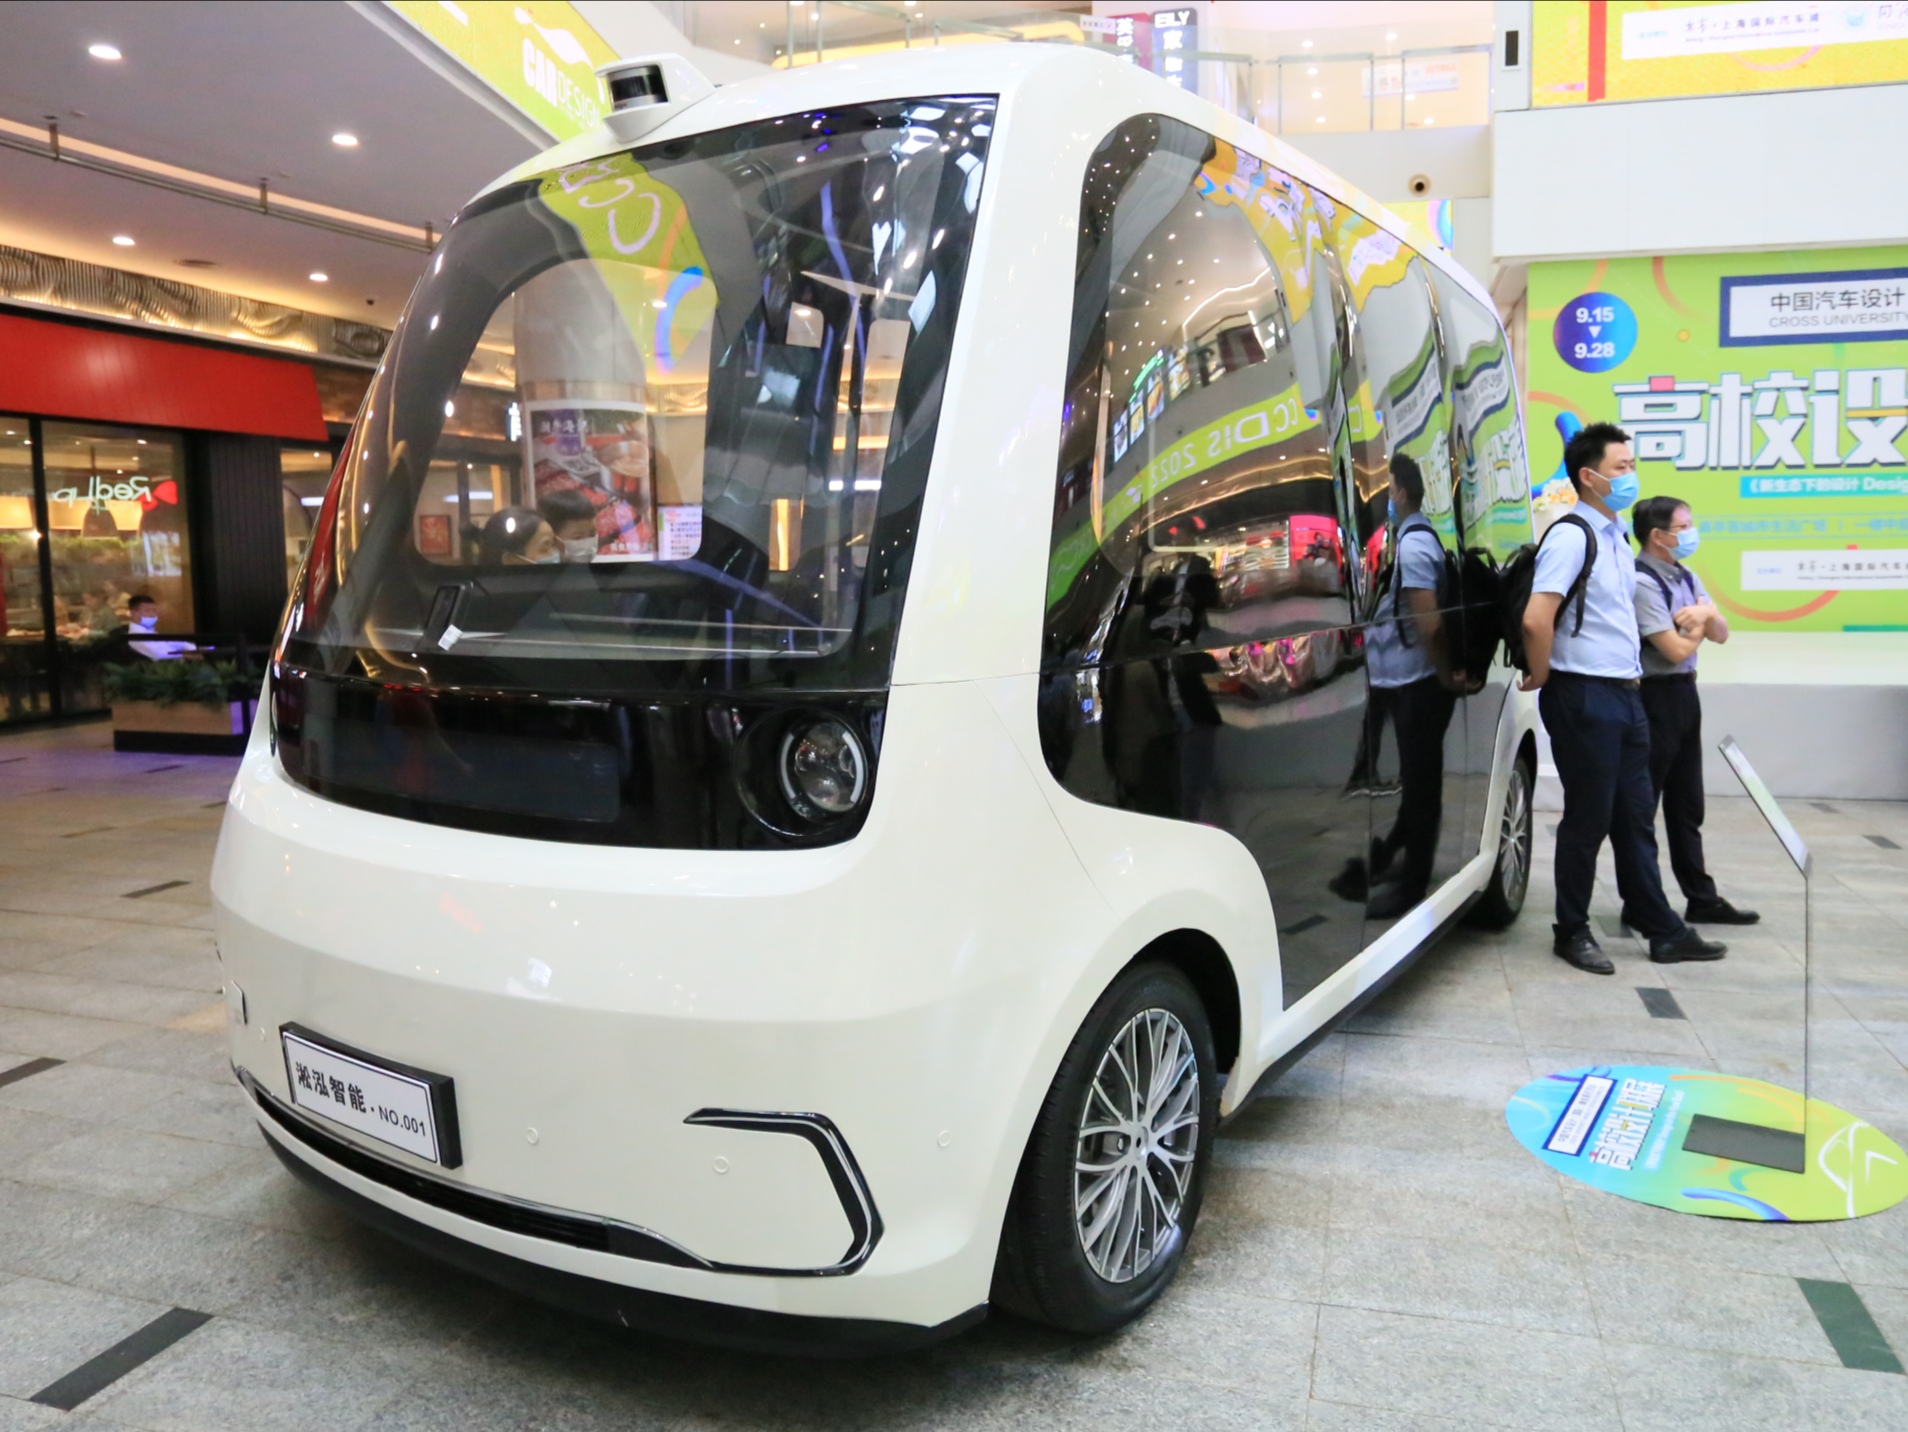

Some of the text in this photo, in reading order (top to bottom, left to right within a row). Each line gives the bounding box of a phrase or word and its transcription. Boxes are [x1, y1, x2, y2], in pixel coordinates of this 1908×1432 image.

[1770, 287, 1905, 313] 中国汽车设计
[1576, 306, 1615, 323] 9.15
[1769, 315, 1820, 328] CROSS
[1574, 342, 1616, 359] 9.28
